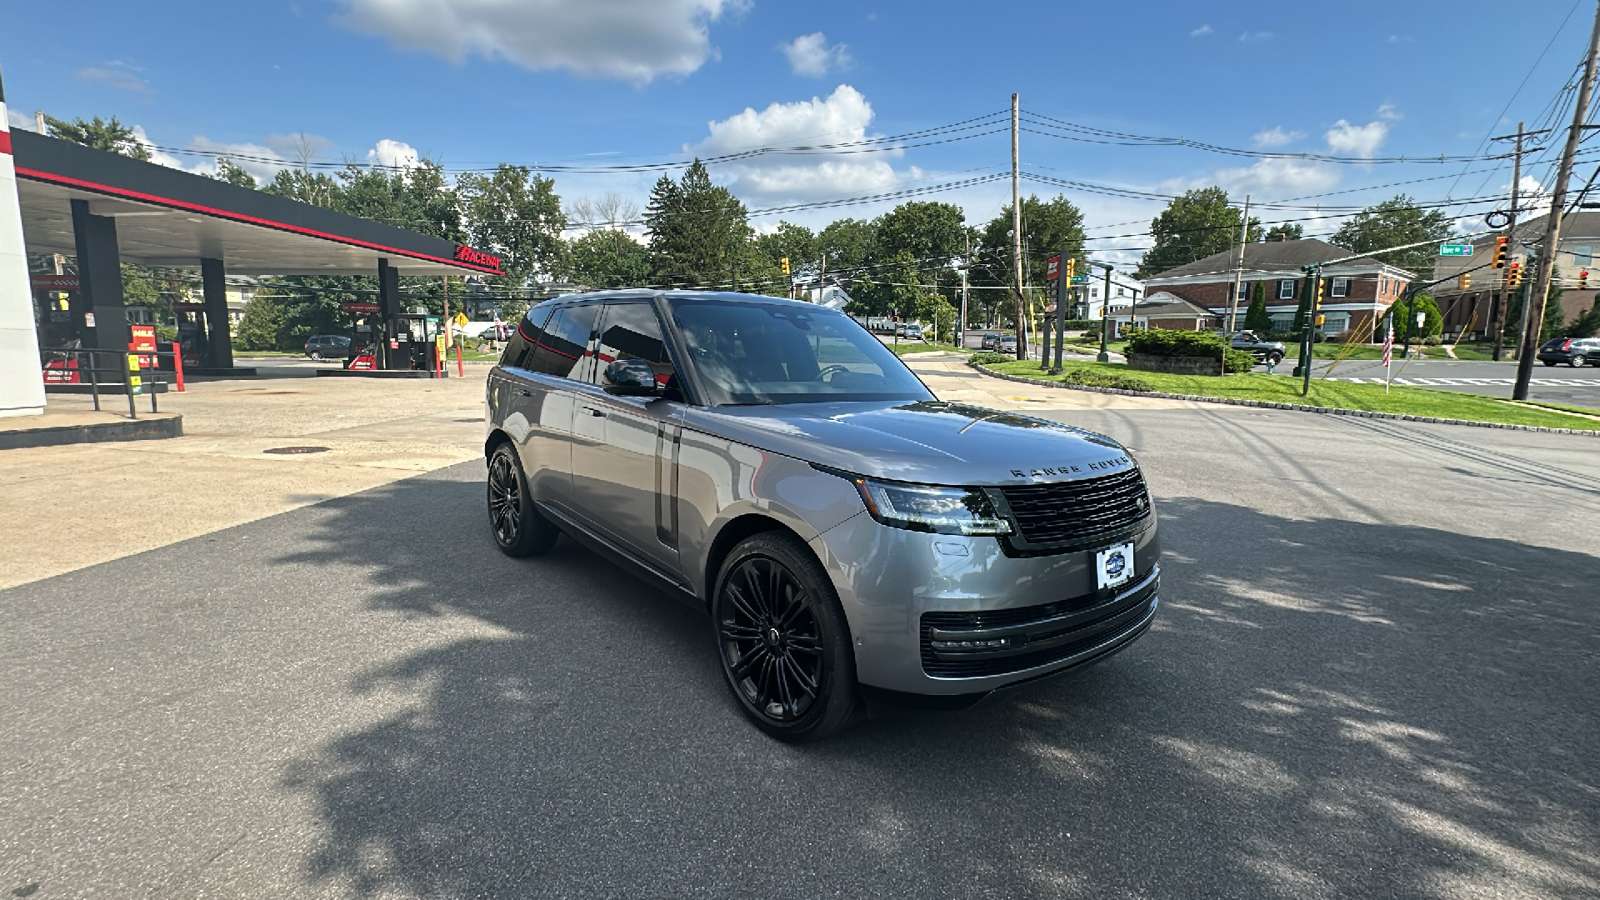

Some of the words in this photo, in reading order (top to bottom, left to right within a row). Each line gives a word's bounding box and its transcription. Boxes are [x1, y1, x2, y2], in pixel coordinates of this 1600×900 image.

[456, 245, 501, 270] RACEWAY
[1010, 465, 1082, 478] RANGE
[1087, 456, 1129, 471] ROVER
